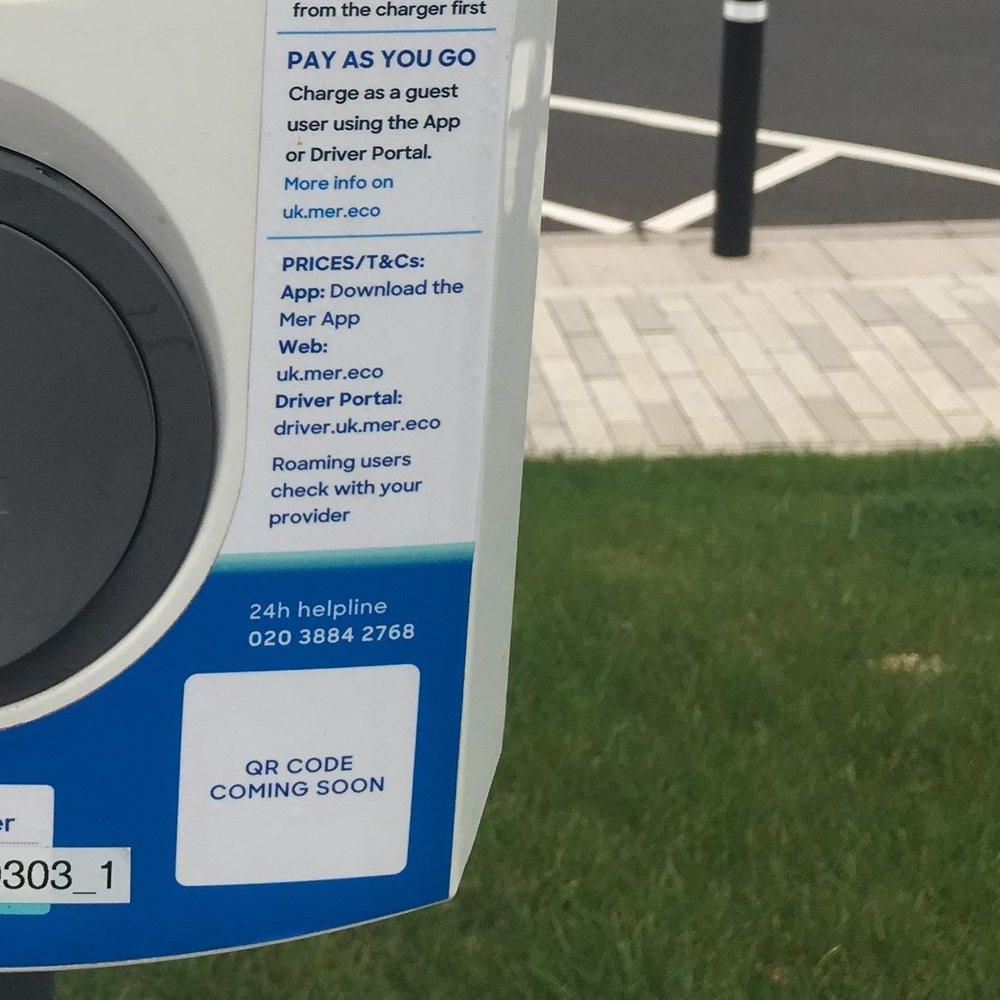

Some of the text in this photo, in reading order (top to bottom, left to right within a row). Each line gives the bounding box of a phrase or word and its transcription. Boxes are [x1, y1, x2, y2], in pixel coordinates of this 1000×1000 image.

[293, 0, 486, 20] from the charger first
[288, 48, 476, 69] PAY AS YOU GO
[289, 84, 459, 104] Charge as a guest
[287, 114, 461, 134] user using the App
[286, 144, 432, 162] or Driver Portal.
[284, 175, 393, 191] More info on
[283, 204, 381, 219] uk.mer.eco
[282, 254, 425, 272] PRICES/T&Cs:
[280, 278, 464, 303] App: Download the
[280, 311, 360, 330] Mer App
[279, 338, 328, 354] Web:
[277, 366, 384, 382] uk.mer.eco
[276, 389, 402, 409] Driver Portal:
[274, 418, 441, 436] driver.uk.mer.eco
[272, 455, 411, 473] Roaming users
[271, 480, 423, 498] check with your
[269, 507, 351, 528] provider
[250, 598, 387, 620] 24h helpline
[249, 623, 414, 647] 020 3884 2768
[245, 755, 353, 776] QR CODE
[210, 776, 384, 800] COMING SOON
